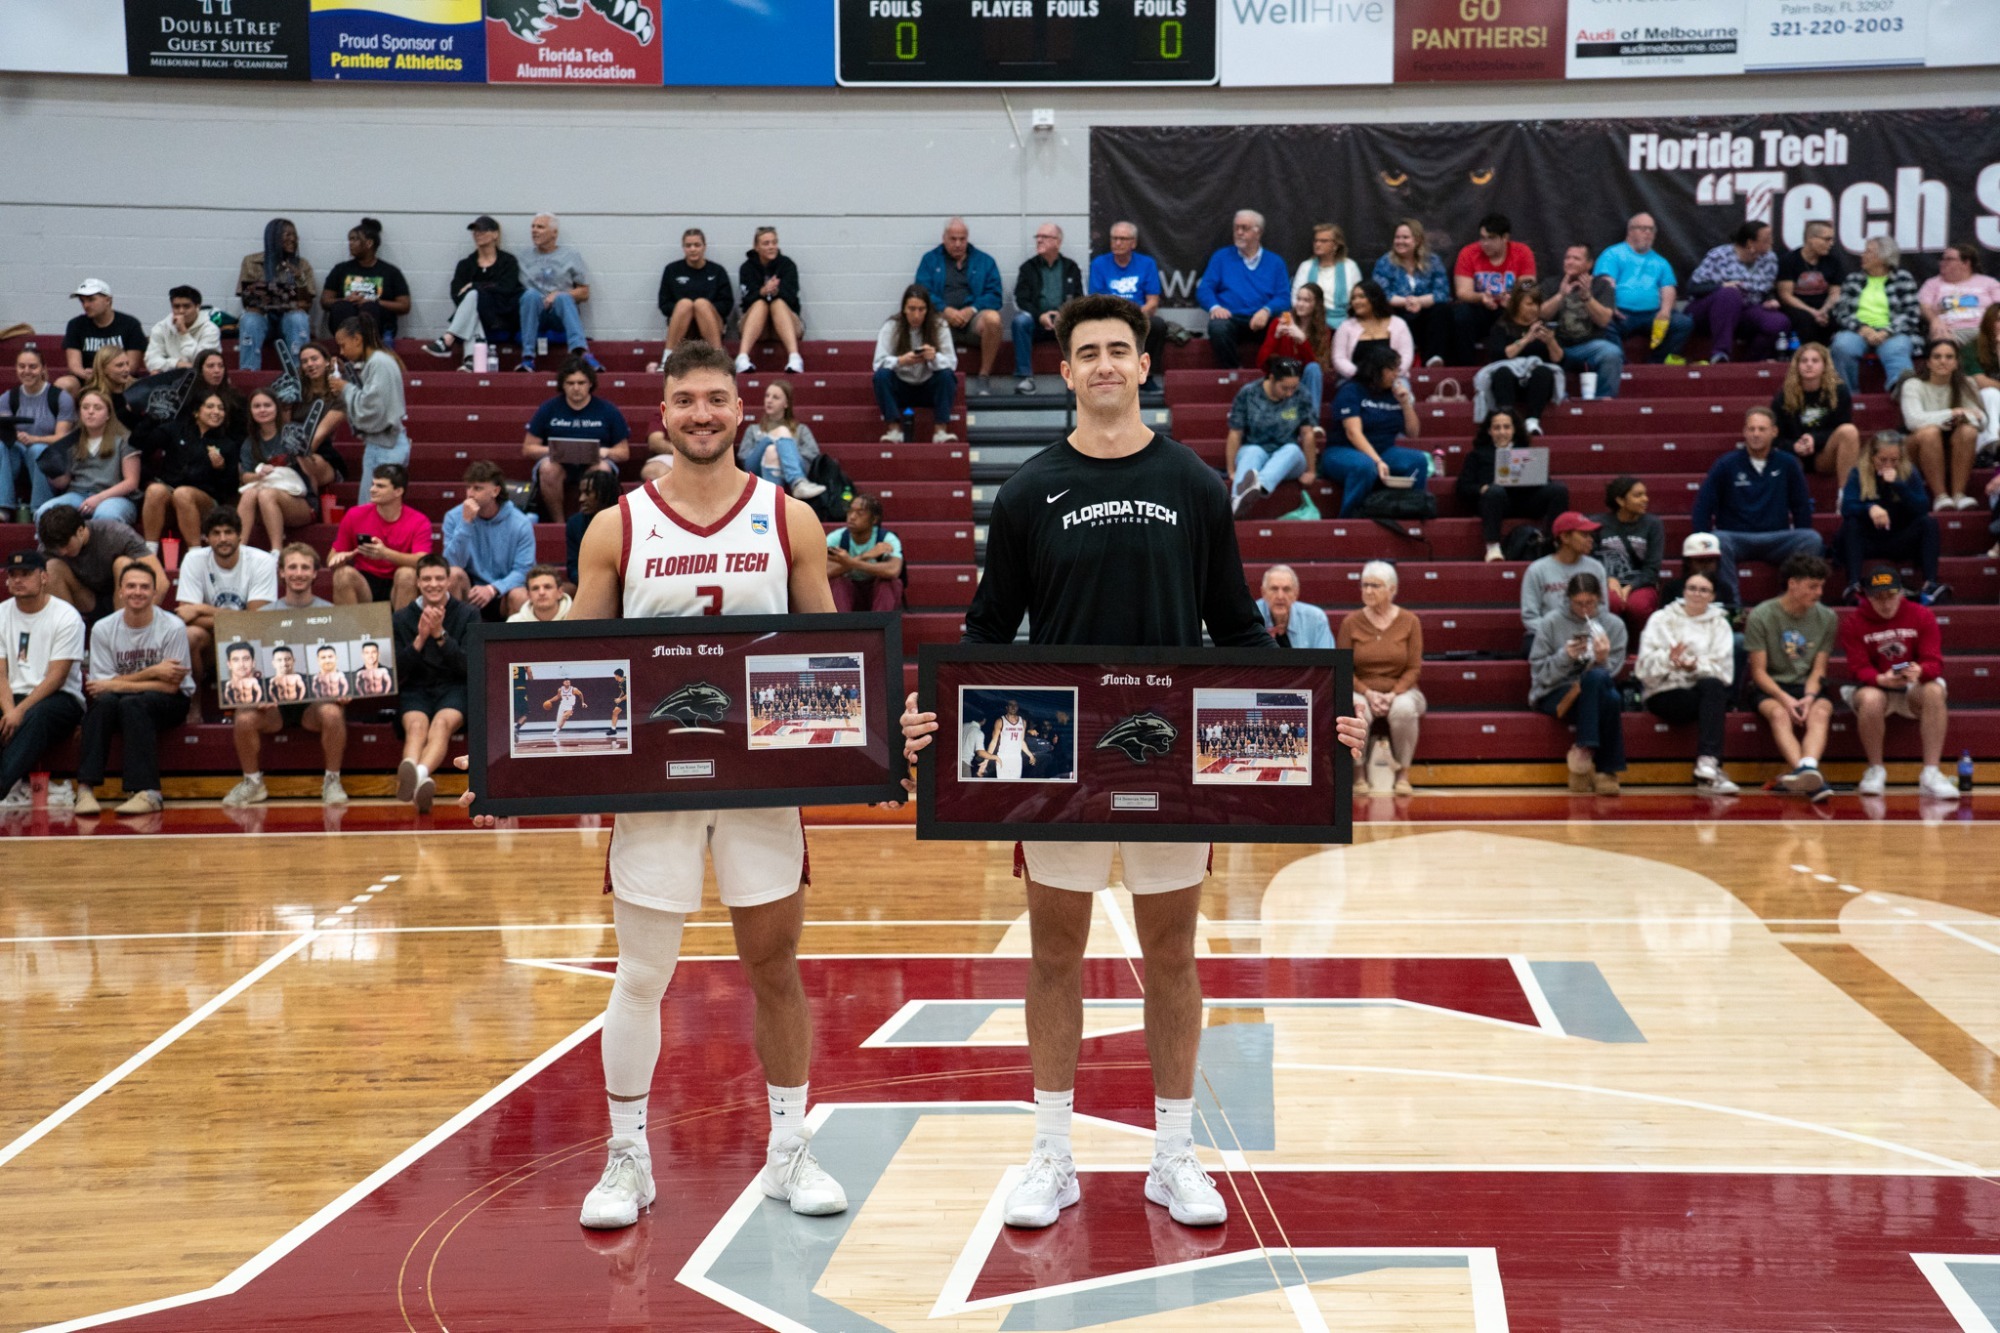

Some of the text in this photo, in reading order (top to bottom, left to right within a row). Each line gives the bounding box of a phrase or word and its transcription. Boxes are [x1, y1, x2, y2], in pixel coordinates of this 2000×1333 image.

[869, 0, 1187, 18] FOULS PLAYER FOULS FOULS
[1236, 0, 1383, 25] WellHive
[1459, 0, 1501, 21] GO
[1576, 26, 1739, 42] Audi of Melbourne
[1769, 17, 1905, 37] 321-220-2003
[338, 33, 454, 52] Proud Sponsor of
[895, 22, 918, 60] 0
[1159, 20, 1182, 59] 0
[1411, 26, 1548, 50] PANTHERS!
[330, 52, 463, 71] Panther Athletics
[538, 47, 614, 63] Florida Tech
[516, 63, 637, 80] Alumni Association
[1628, 128, 1850, 171] Florida Tech
[1474, 270, 1516, 294] USA
[1062, 499, 1178, 530] FLORIDA TECH
[1091, 516, 1150, 528] PANTHERS
[644, 552, 770, 579] FLORIDA TECH
[652, 643, 724, 658] Florida Tech
[1100, 673, 1173, 688] Florida Tech
